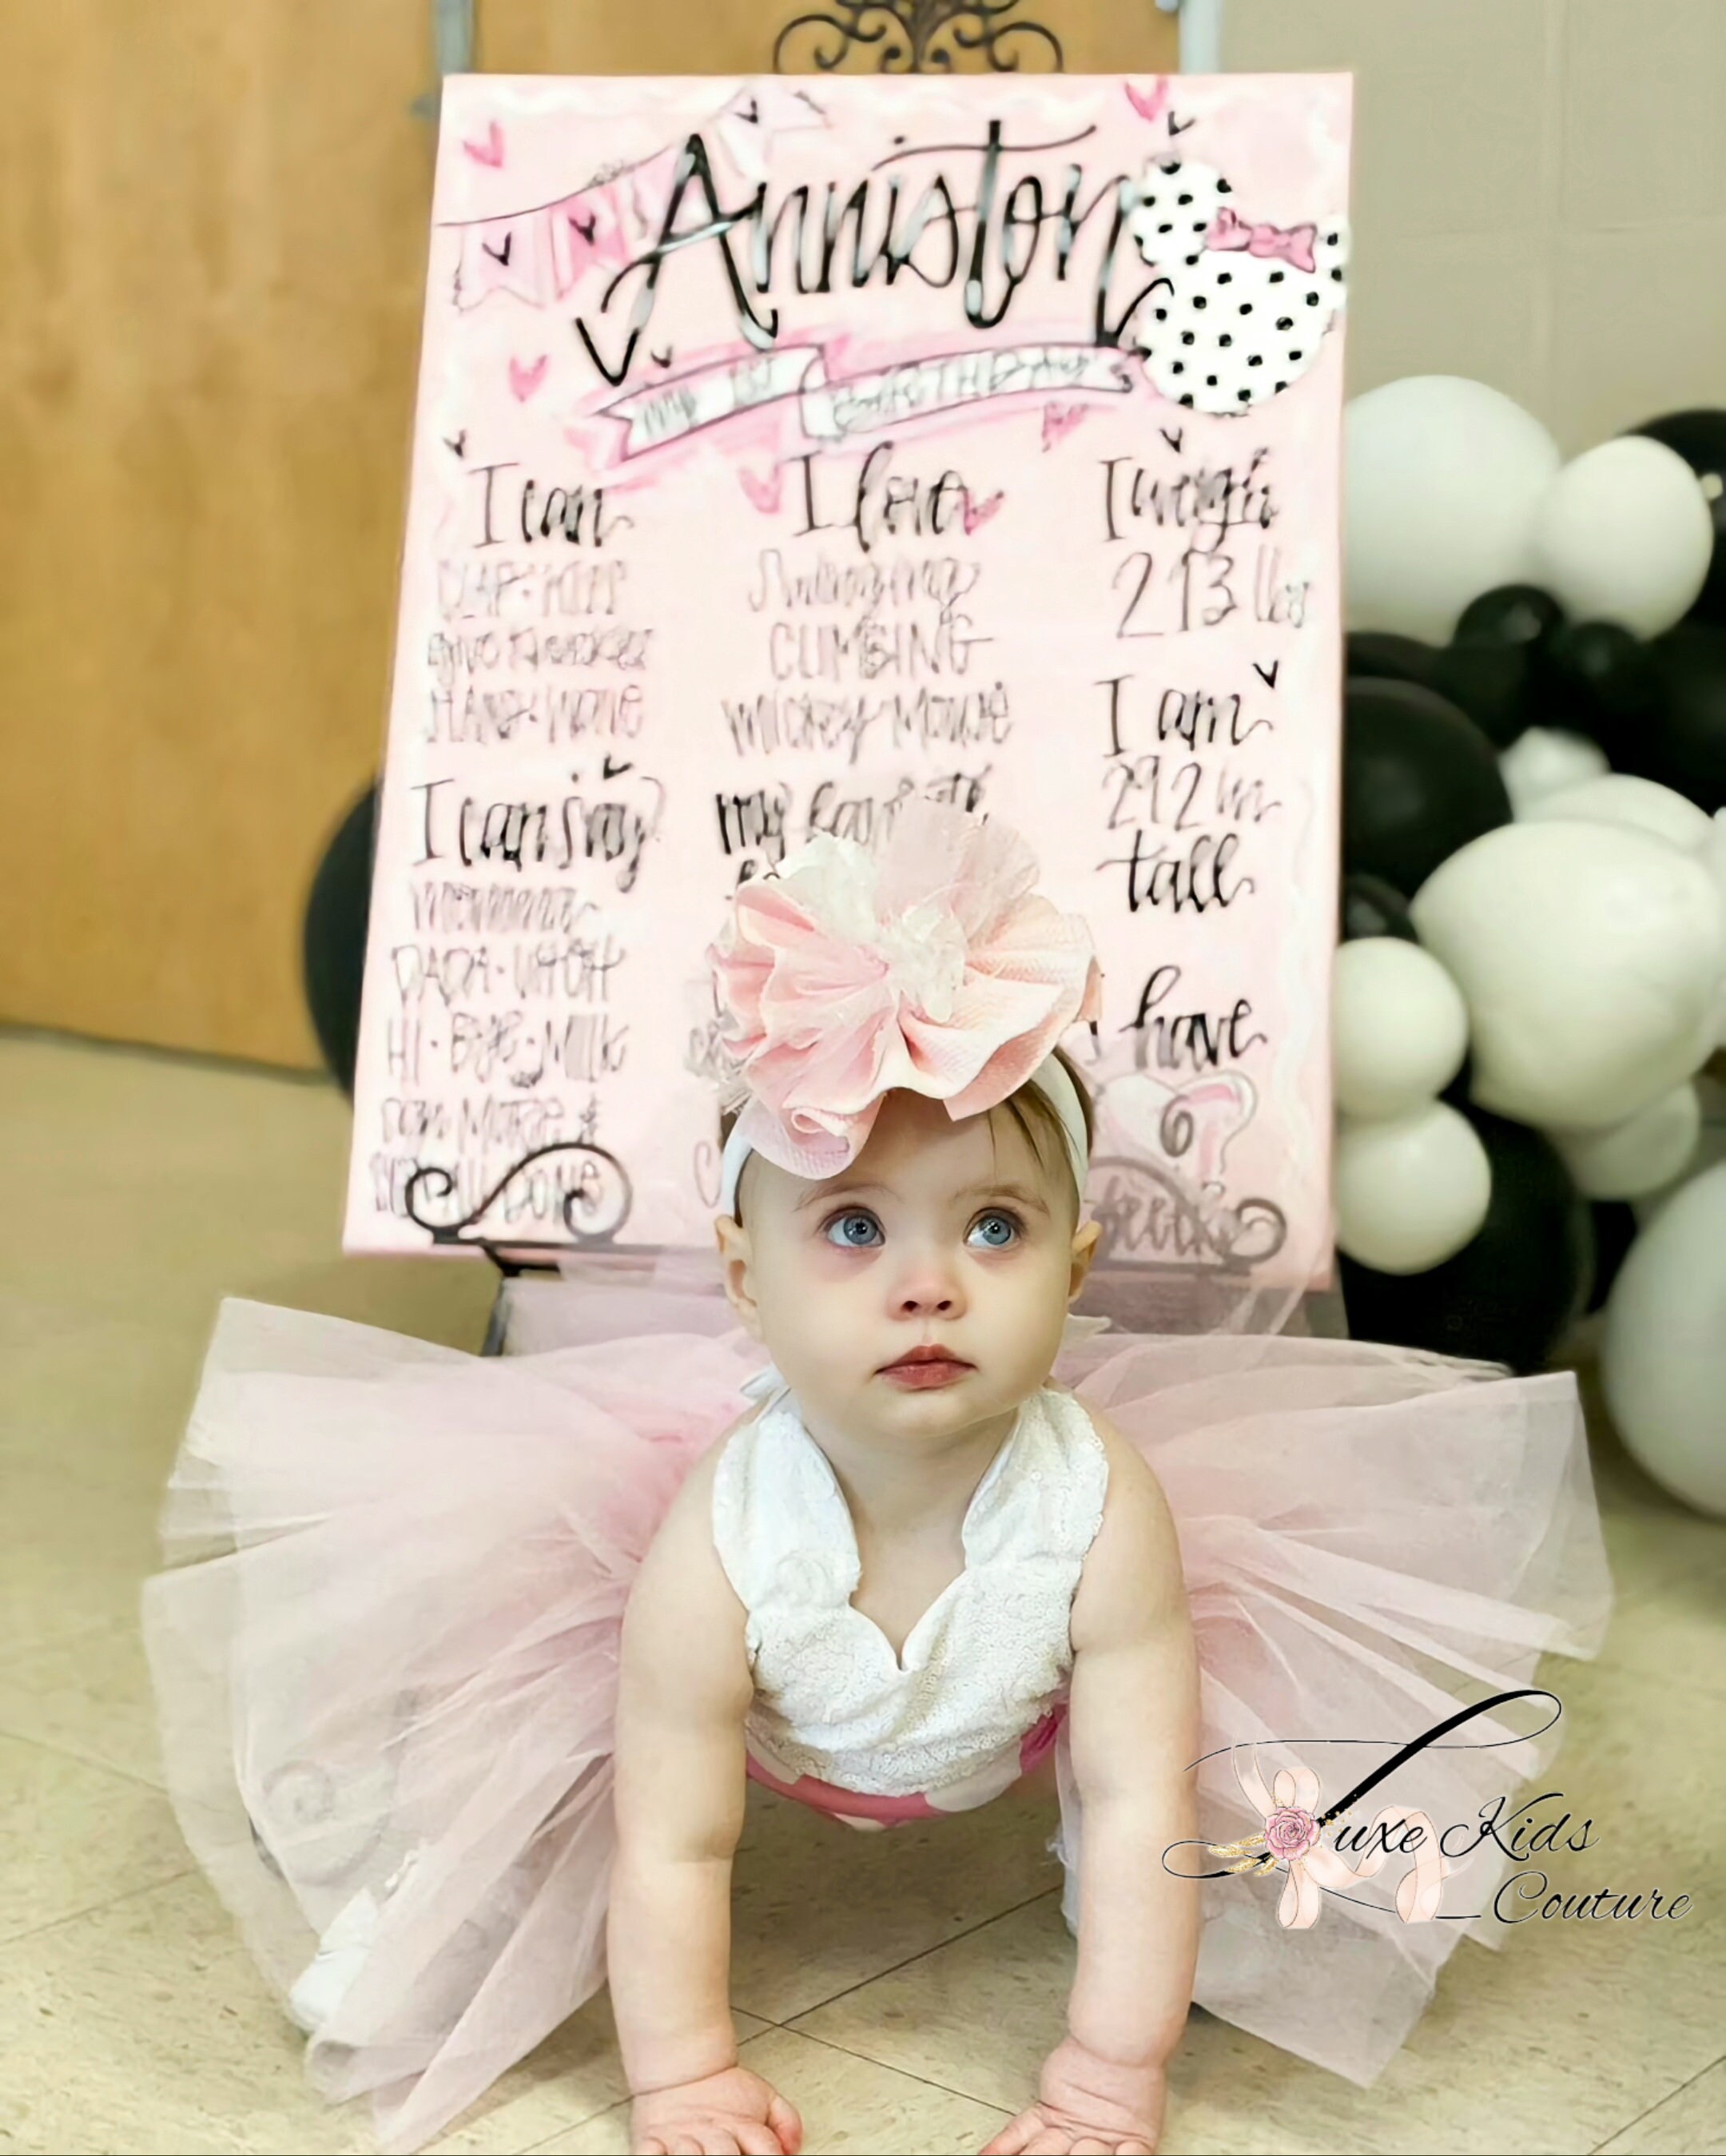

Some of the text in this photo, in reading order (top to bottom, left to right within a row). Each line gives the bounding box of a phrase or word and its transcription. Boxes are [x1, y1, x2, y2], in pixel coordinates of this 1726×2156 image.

[574, 118, 1175, 386] Anniston
[468, 462, 635, 549] I can
[781, 449, 836, 537] I
[1093, 674, 1274, 758] I am
[1095, 828, 1256, 913] tall
[1119, 965, 1268, 1072] have
